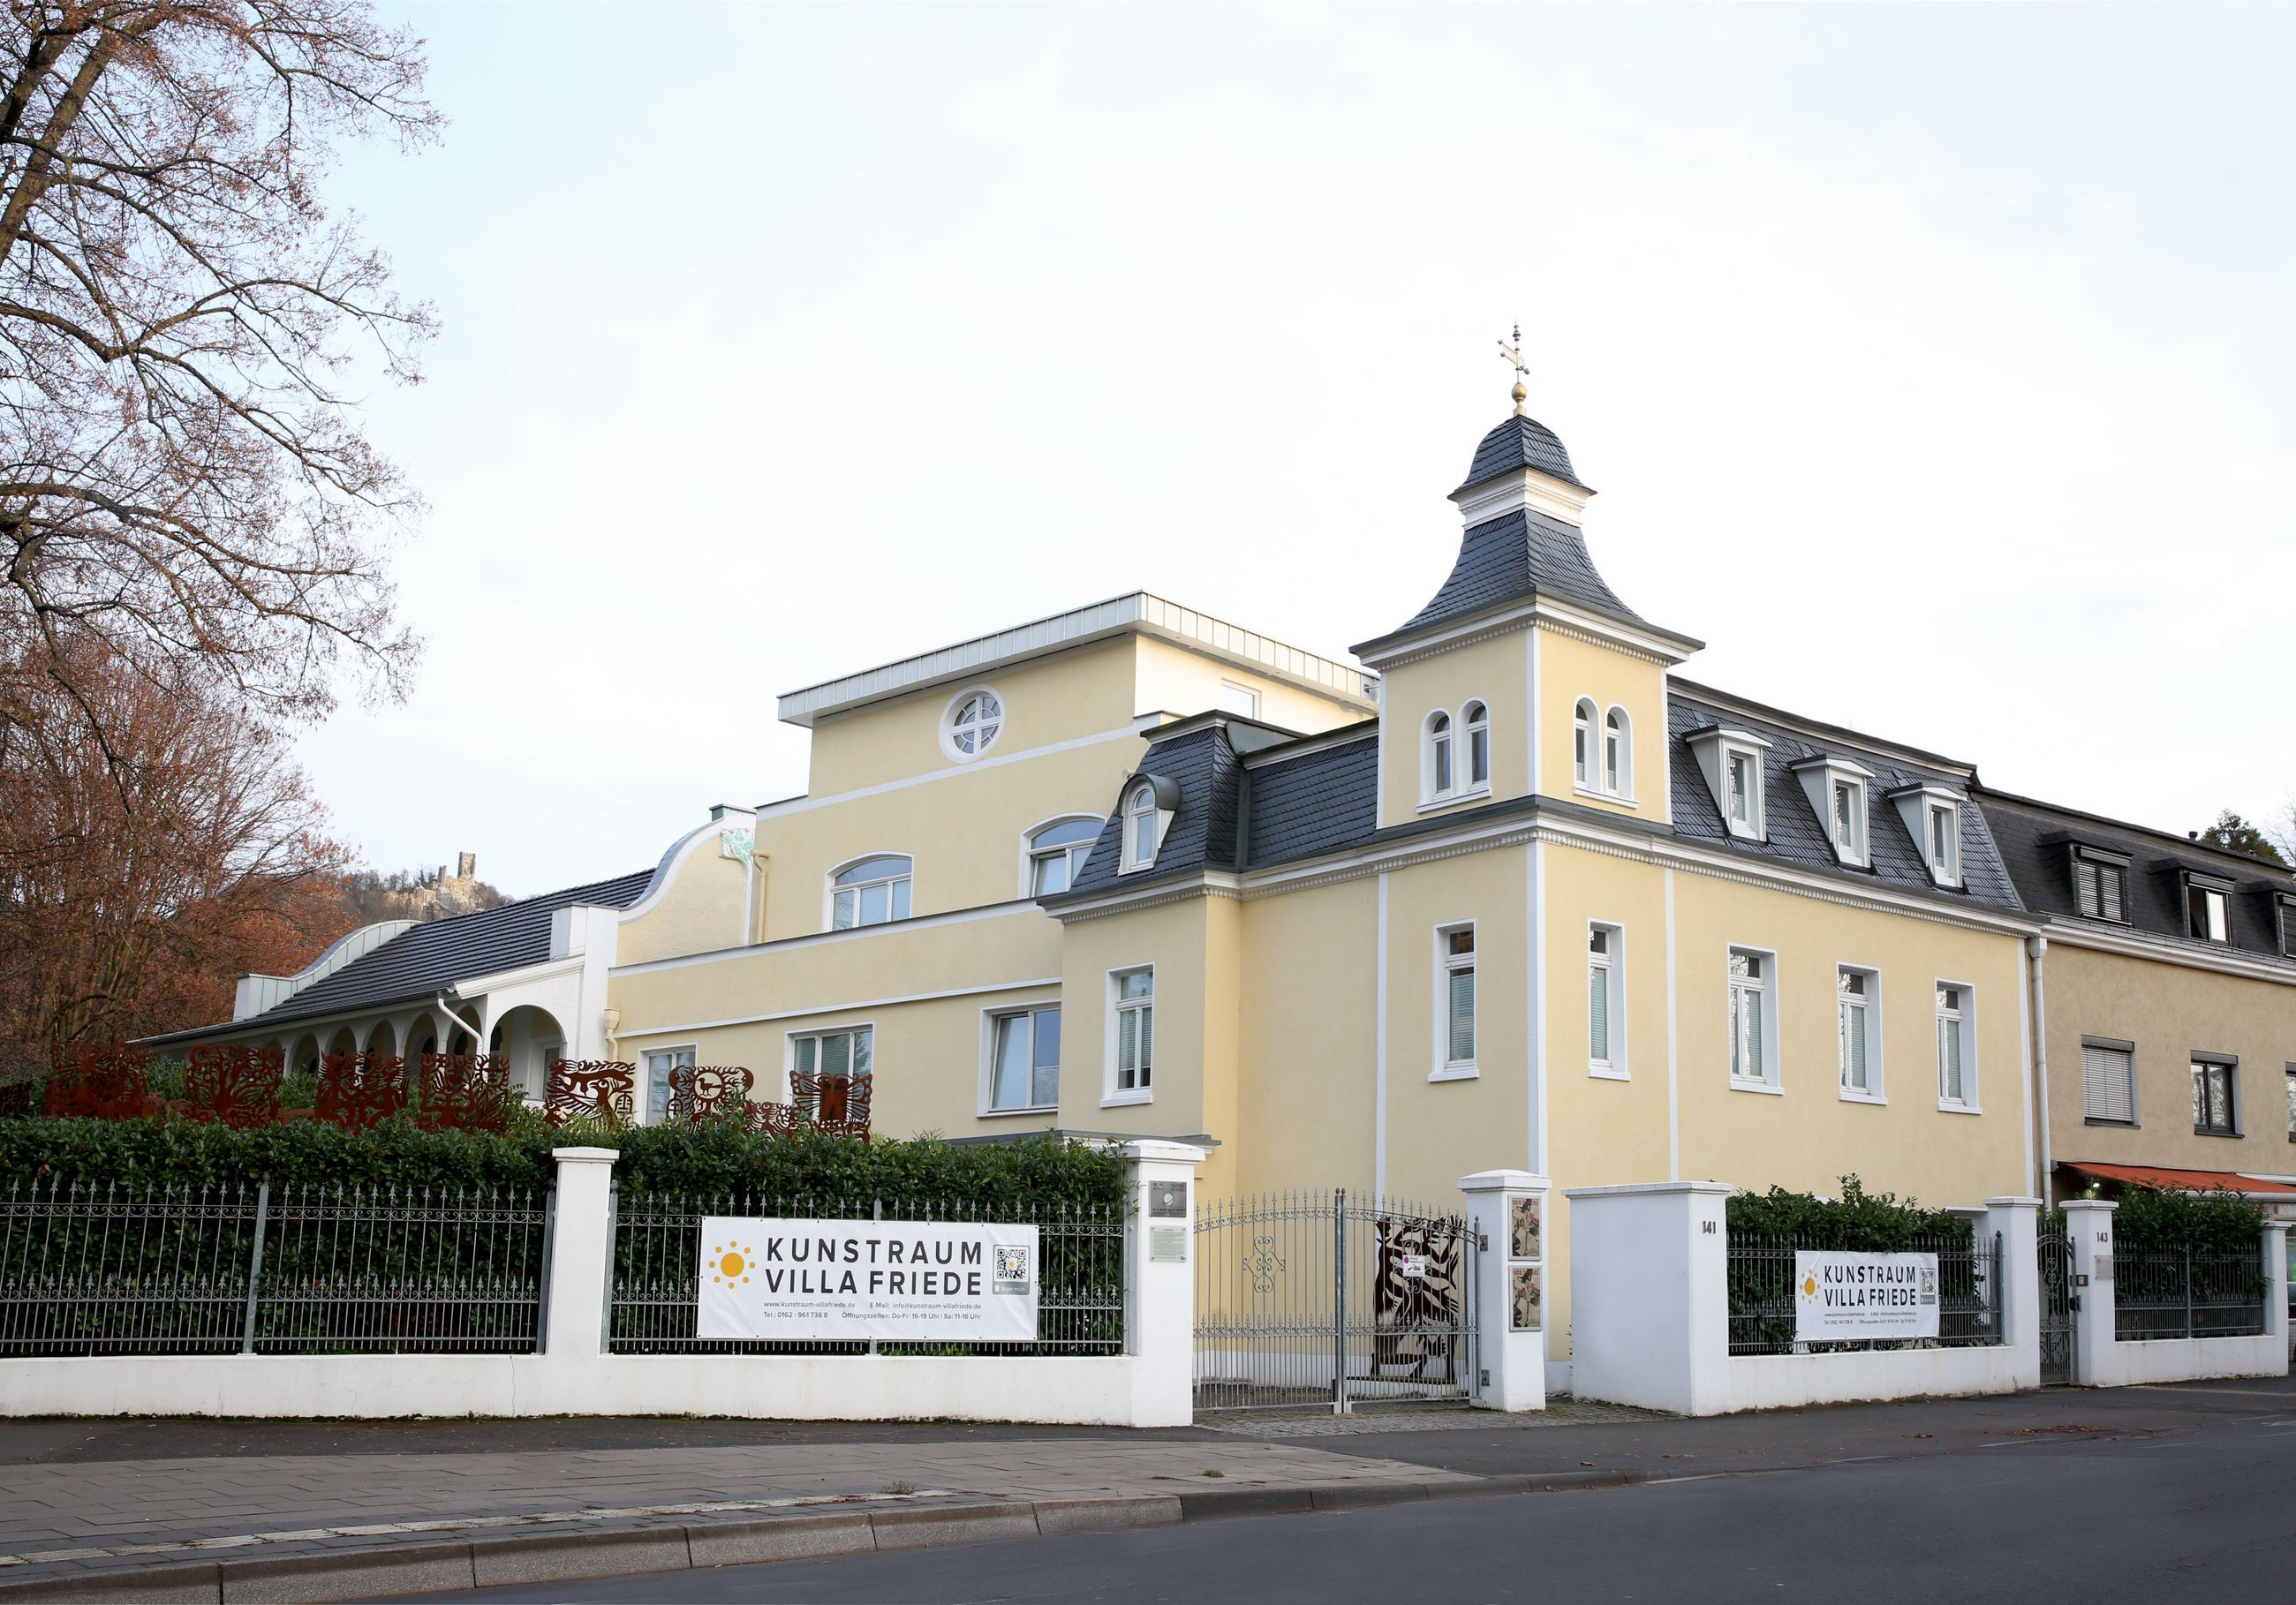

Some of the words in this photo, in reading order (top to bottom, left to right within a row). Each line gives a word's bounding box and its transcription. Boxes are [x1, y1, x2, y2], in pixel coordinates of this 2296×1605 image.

[1703, 1220, 1716, 1234] 141
[2096, 1232, 2109, 1243] 143
[767, 1237, 981, 1265] KUNSTRAUM
[766, 1269, 857, 1294] VILLA
[869, 1270, 981, 1296] FRIEDE
[1824, 1265, 1915, 1284] KUNSTRAUM
[1824, 1288, 1865, 1307] VILLA
[1869, 1288, 1916, 1306] FRIEDE
[842, 1312, 890, 1321] Öffnungszeiten:
